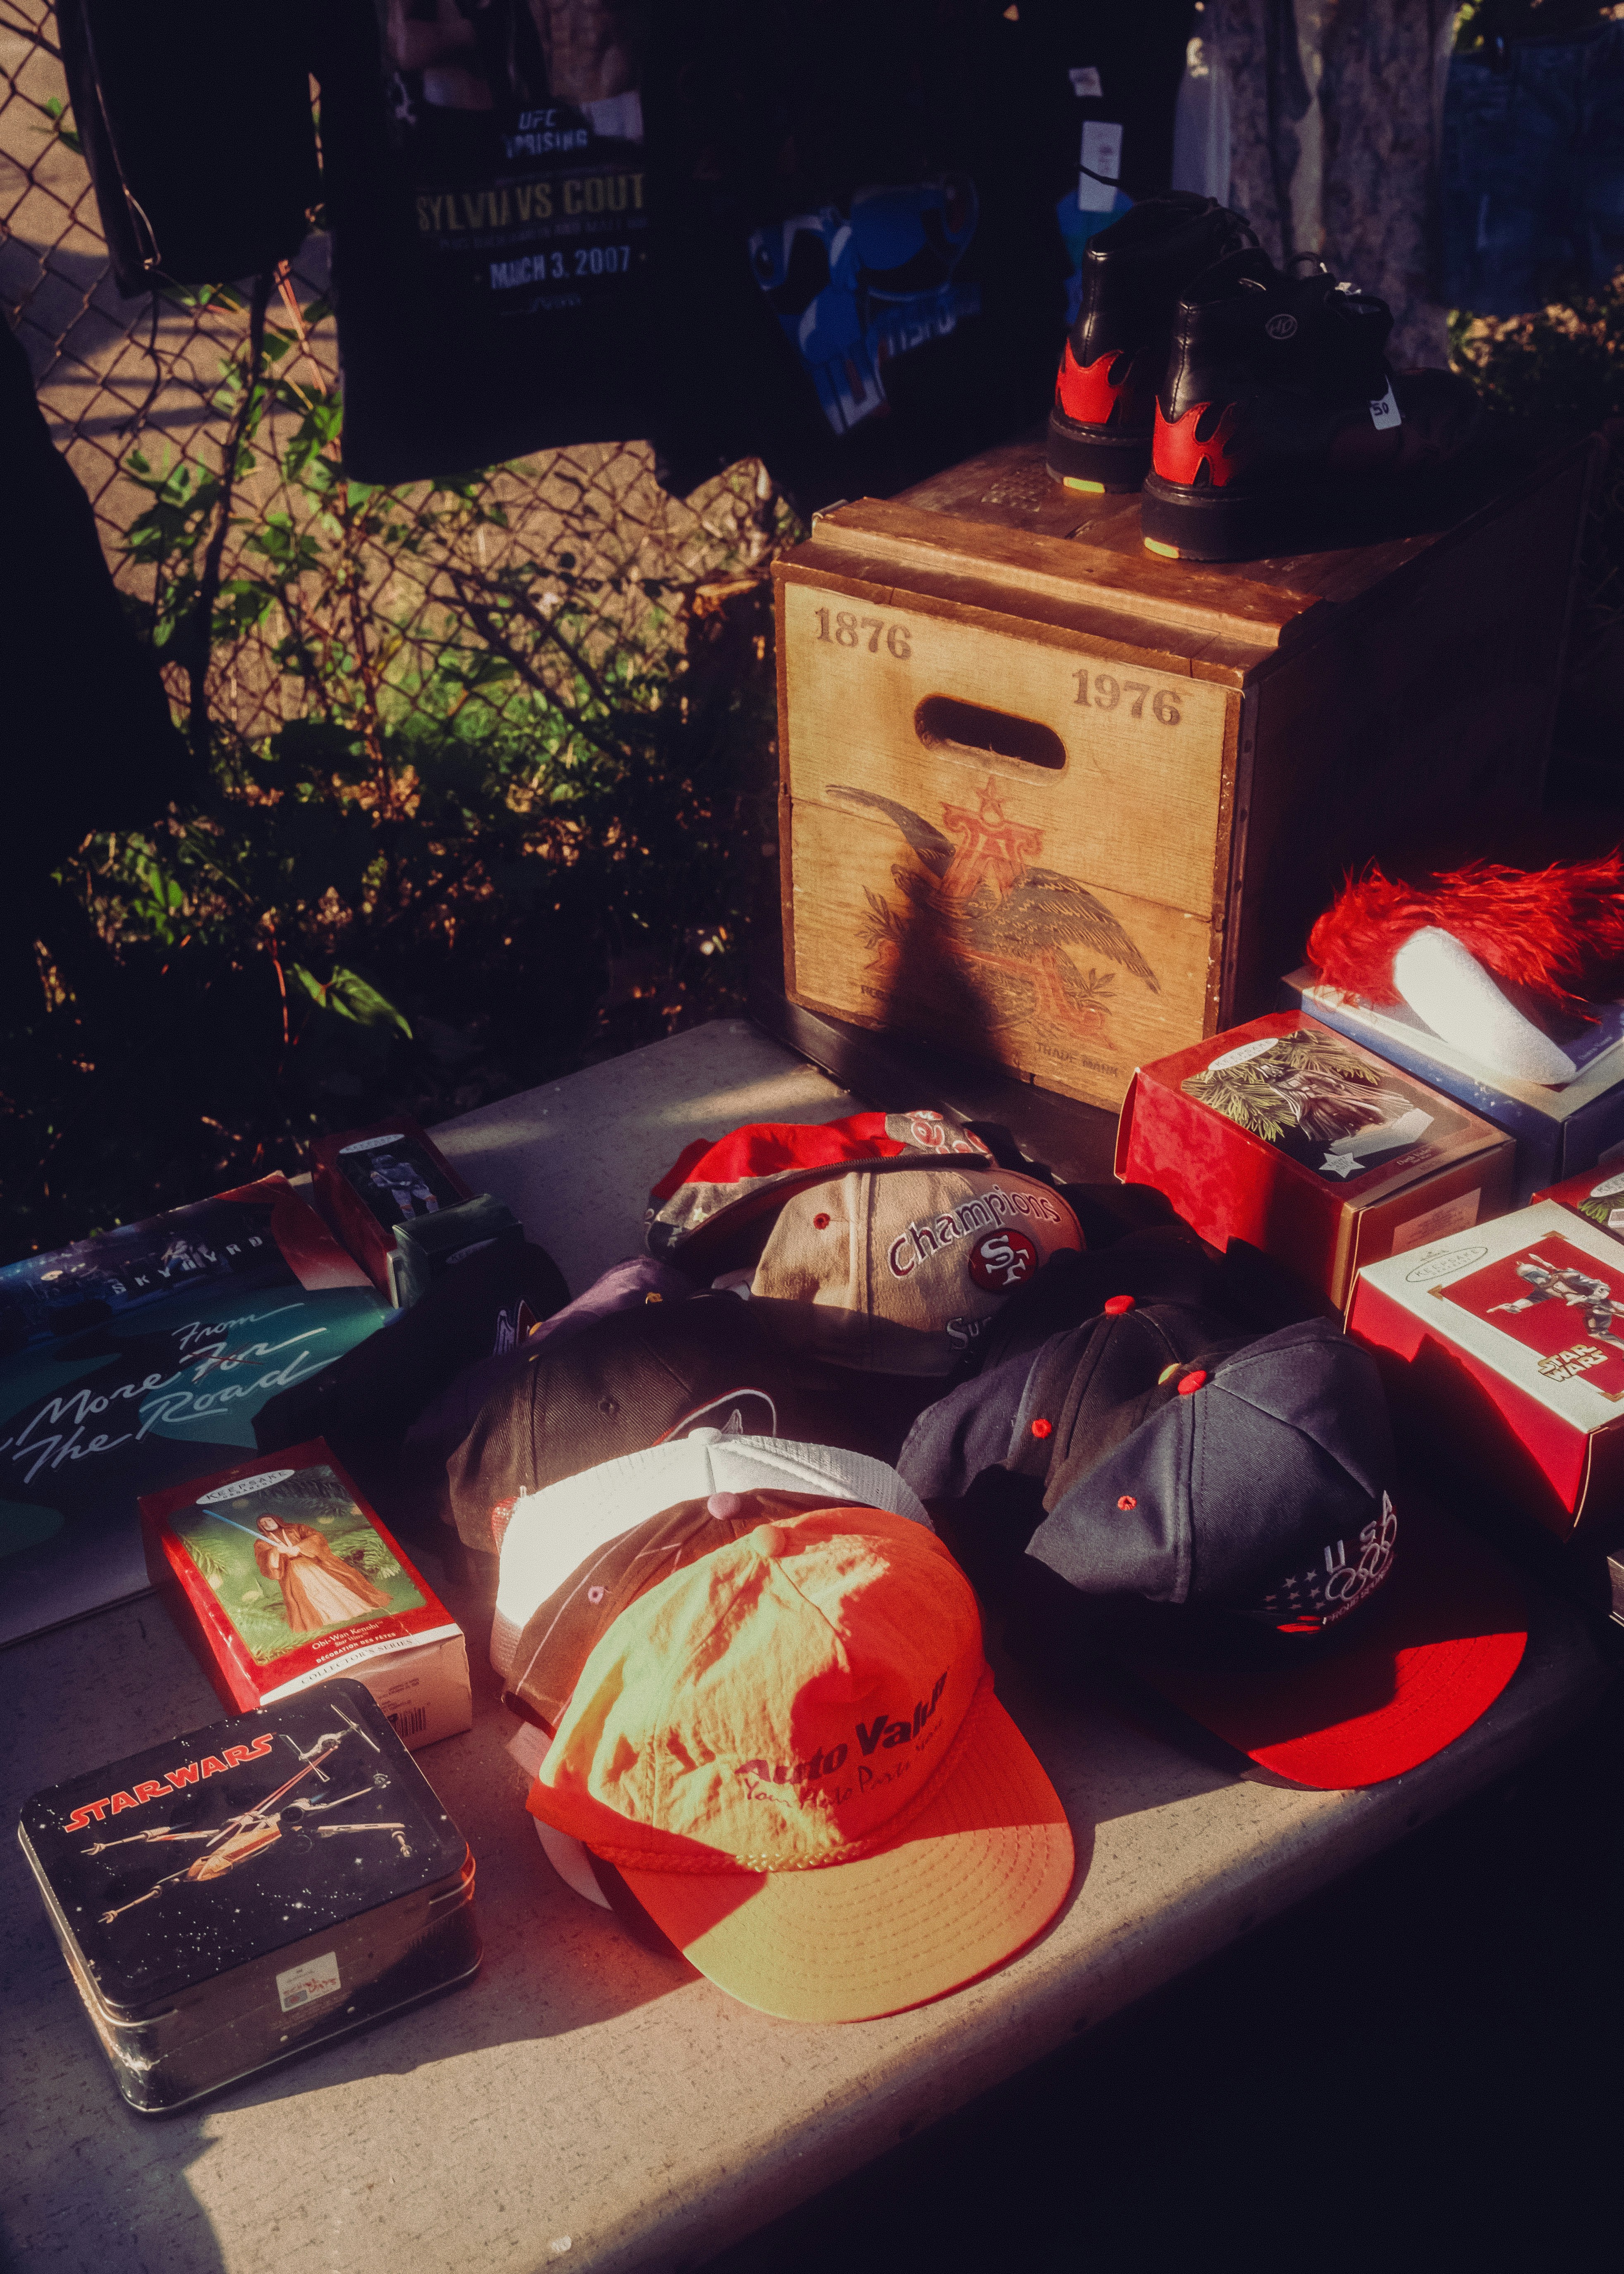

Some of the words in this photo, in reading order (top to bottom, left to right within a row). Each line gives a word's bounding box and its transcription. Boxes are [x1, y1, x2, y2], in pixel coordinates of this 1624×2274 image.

[518, 109, 557, 130] UFC
[515, 182, 553, 222] VS
[574, 245, 631, 277] 2007
[815, 607, 913, 660] 1876
[1072, 668, 1182, 727] 1976
[1035, 1041, 1077, 1064] TRADE
[887, 1183, 1061, 1280] Champions
[980, 1234, 1030, 1286] SF
[171, 1302, 305, 1351] From
[1538, 1343, 1599, 1374] STAR
[1541, 1349, 1609, 1382] WARS
[15, 1370, 182, 1447] More
[179, 1327, 328, 1384] For
[12, 1425, 134, 1485] The
[134, 1350, 344, 1441] Road
[206, 1472, 287, 1500] KEEPSAKE
[1323, 1489, 1393, 1575] USA
[301, 1647, 376, 1685] COLLECTOR'S
[377, 1638, 414, 1652] SERIES
[311, 1632, 349, 1651] Obi-Wan
[316, 1642, 359, 1664] DÉCORATION
[360, 1637, 375, 1645] DES
[376, 1632, 397, 1642] FÊTES
[64, 1779, 174, 1834] STAR
[164, 1732, 278, 1788] WARS
[734, 1743, 849, 1785] Auto
